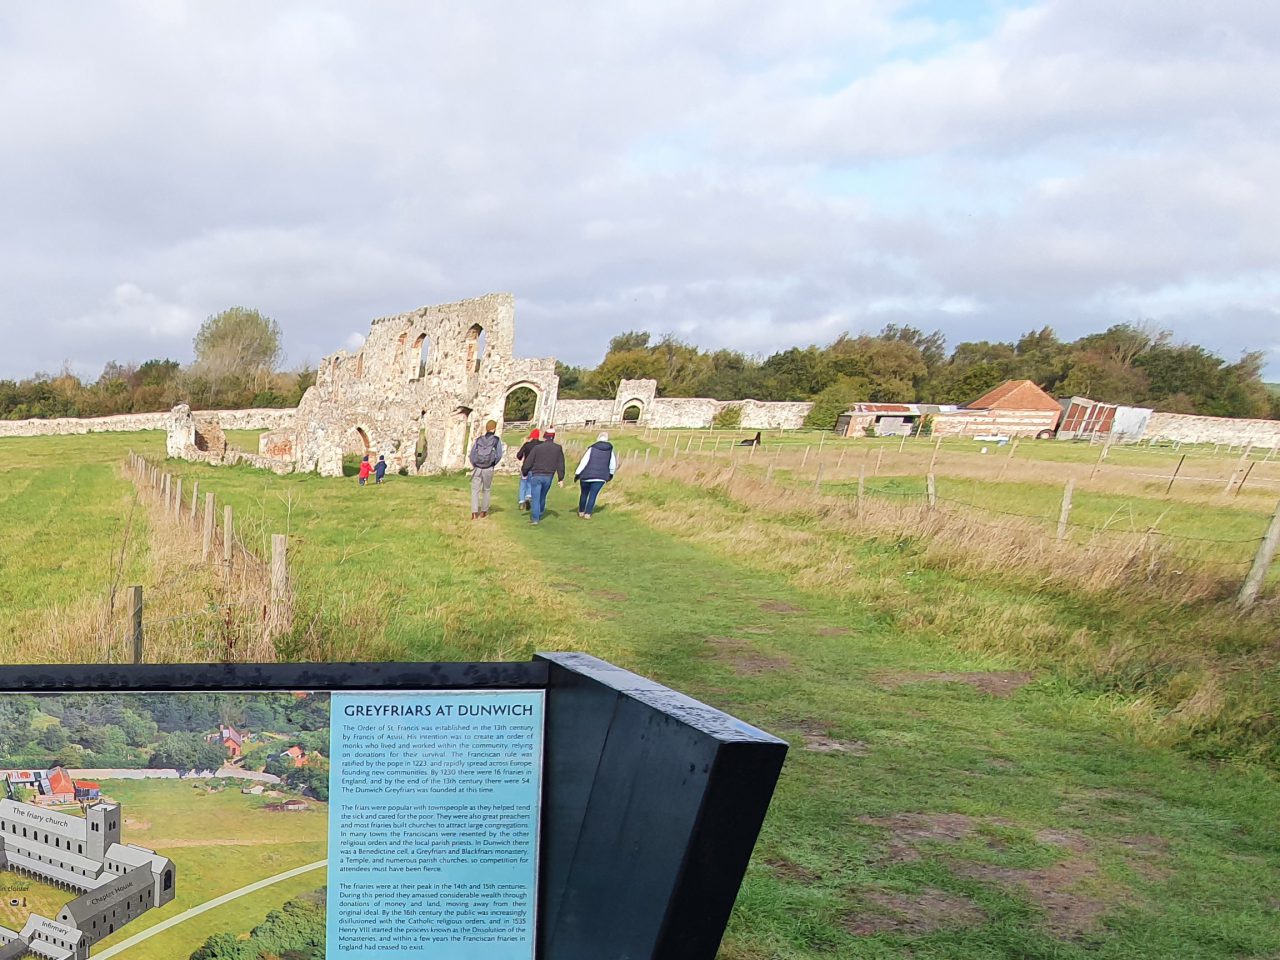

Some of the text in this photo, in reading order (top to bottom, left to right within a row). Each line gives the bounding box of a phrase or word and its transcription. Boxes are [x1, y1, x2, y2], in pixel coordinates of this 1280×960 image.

[345, 705, 533, 716] GREYFRIARS AT DUNWICH
[384, 786, 416, 794] Greyfriars
[12, 808, 68, 828] The friary church
[353, 882, 374, 890] friaries
[416, 883, 432, 891] peak
[90, 882, 133, 905] Chapter House
[42, 921, 68, 935] Infirmary
